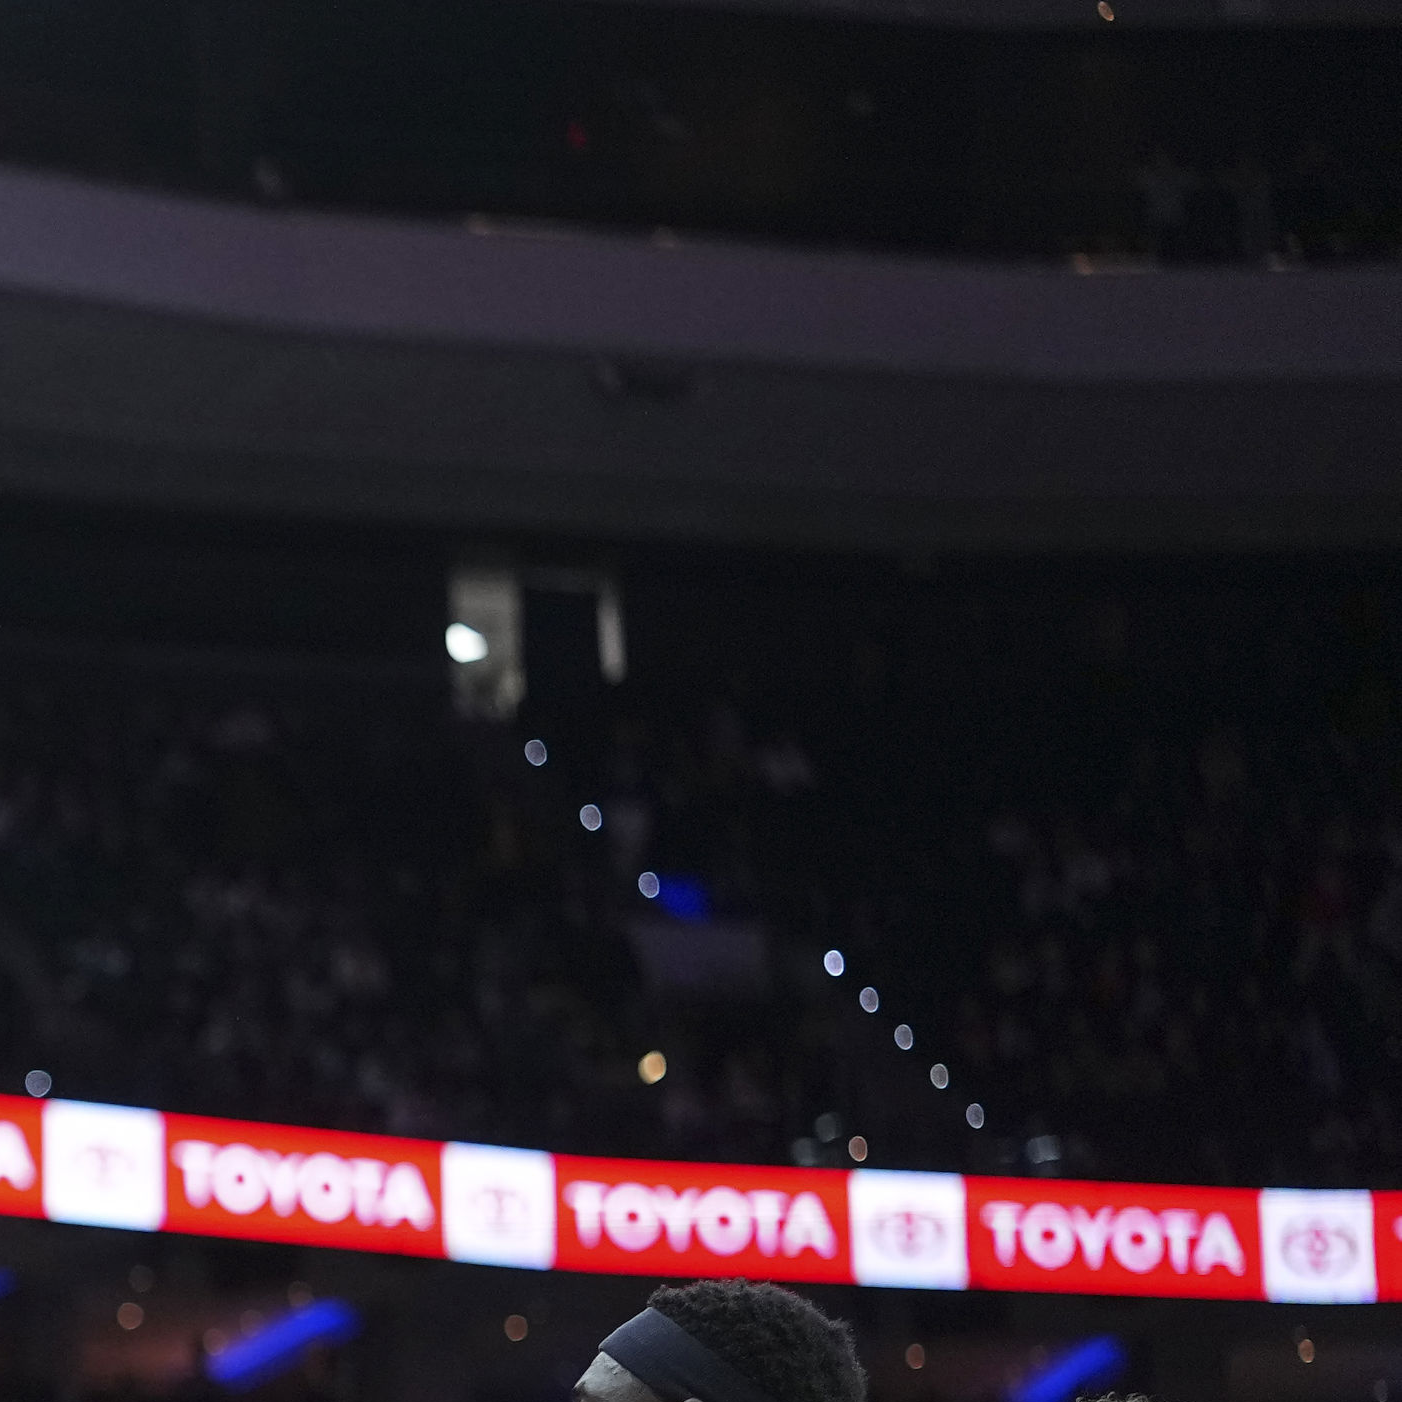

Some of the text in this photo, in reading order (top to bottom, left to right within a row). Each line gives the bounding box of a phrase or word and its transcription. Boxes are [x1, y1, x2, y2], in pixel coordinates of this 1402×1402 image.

[171, 1140, 435, 1232] TOYOTA
[564, 1179, 837, 1259] TOYOTA
[981, 1201, 1245, 1277] TOYOTA
